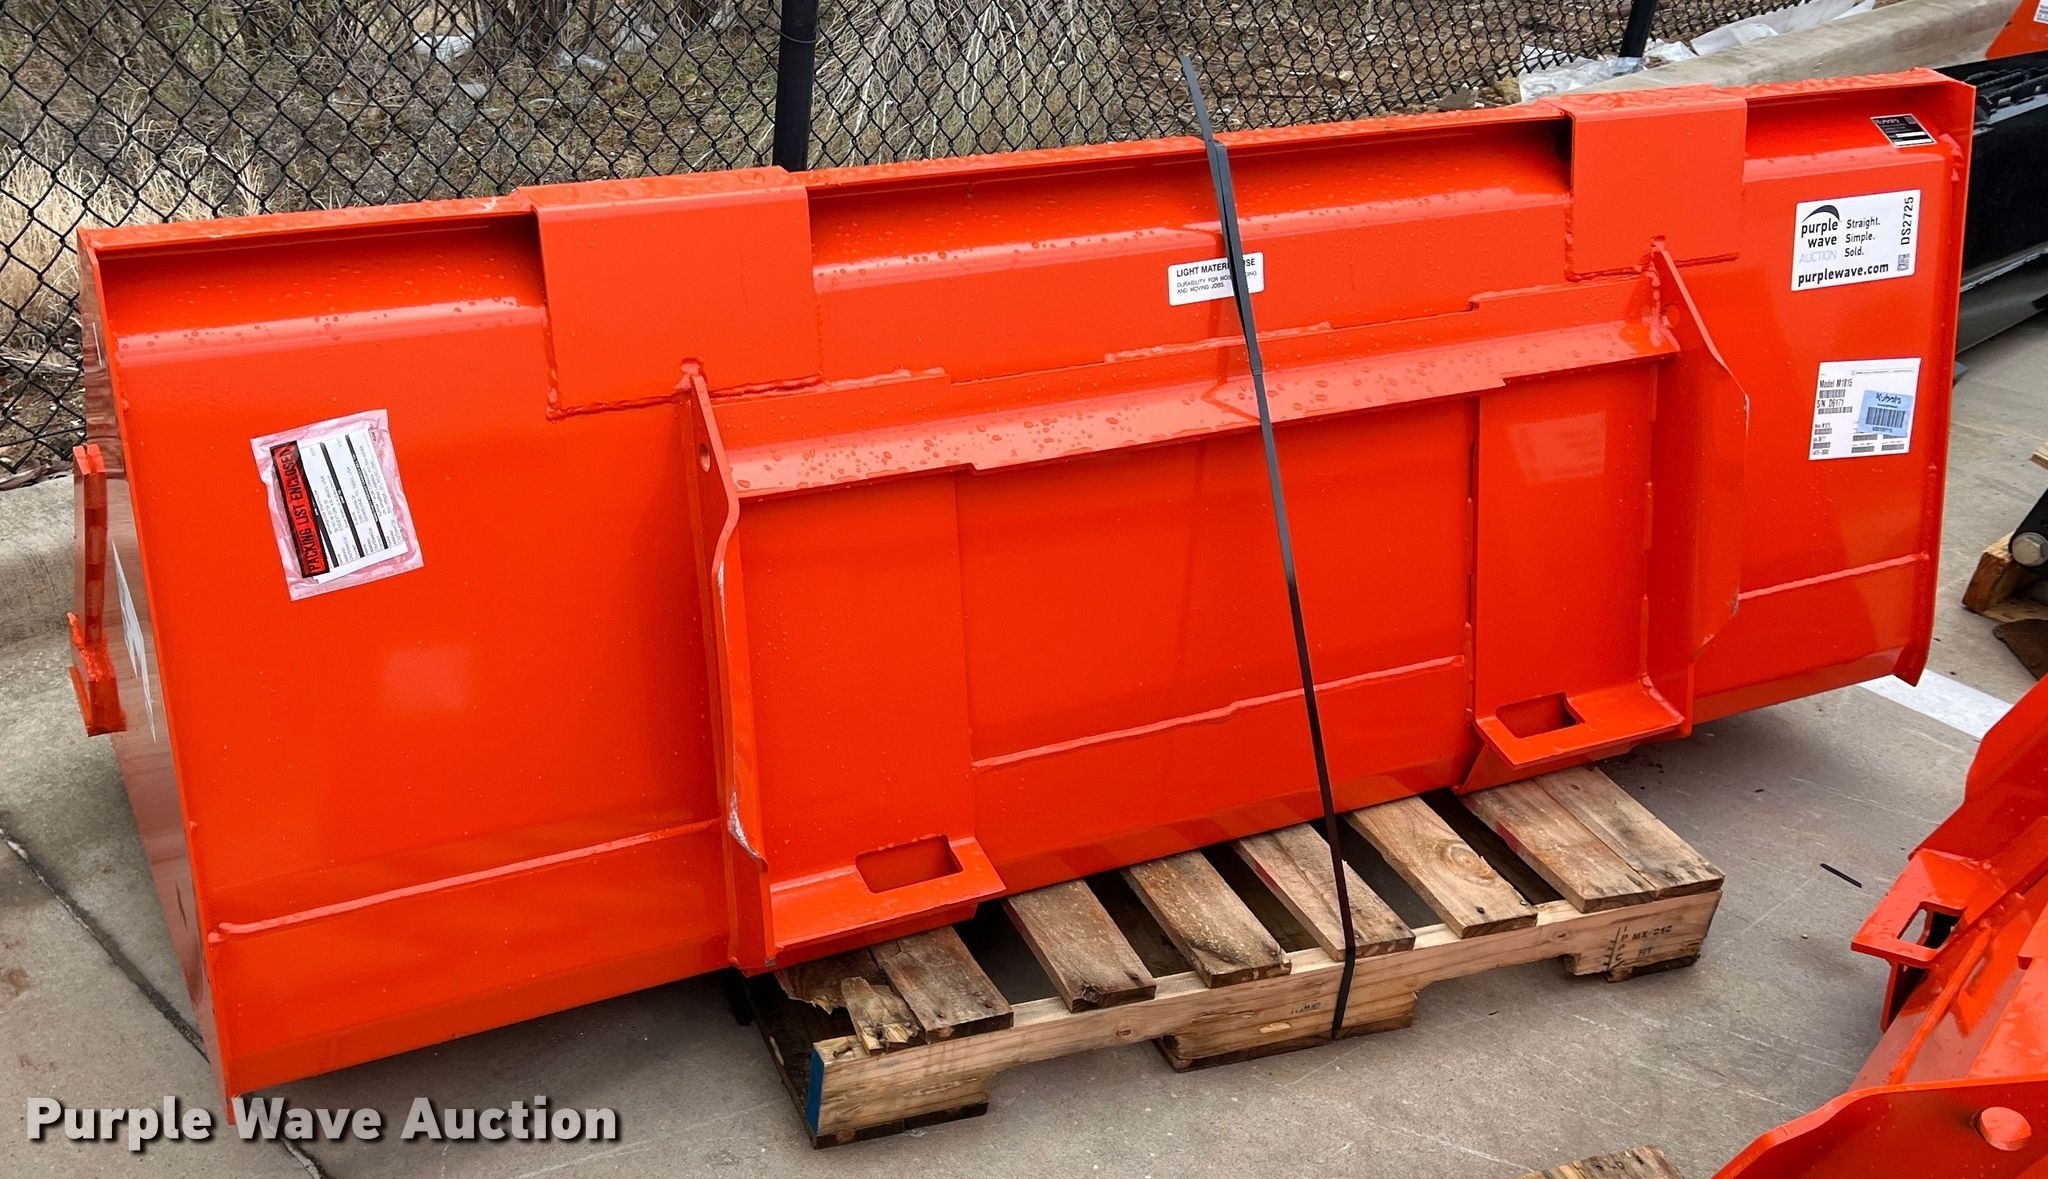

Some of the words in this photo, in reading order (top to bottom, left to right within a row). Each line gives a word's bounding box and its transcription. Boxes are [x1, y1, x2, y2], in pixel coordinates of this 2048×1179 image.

[1846, 217, 1880, 230] Straight.
[1901, 196, 1914, 245] DS2725
[1801, 218, 1838, 239] purple
[1807, 235, 1837, 249] wave
[1845, 232, 1875, 244] Simple.
[1799, 250, 1837, 263] AUCTION
[1844, 246, 1864, 258] Sold.
[1176, 267, 1199, 278] LIGHT
[1798, 263, 1889, 288] purplewave.com
[1177, 279, 1205, 288] DURABILITY
[1820, 380, 1834, 388] Model
[1876, 392, 1902, 404] Kubota
[278, 447, 303, 502] ENCLOSED
[292, 502, 309, 526] LIST
[298, 526, 322, 571] PACKING
